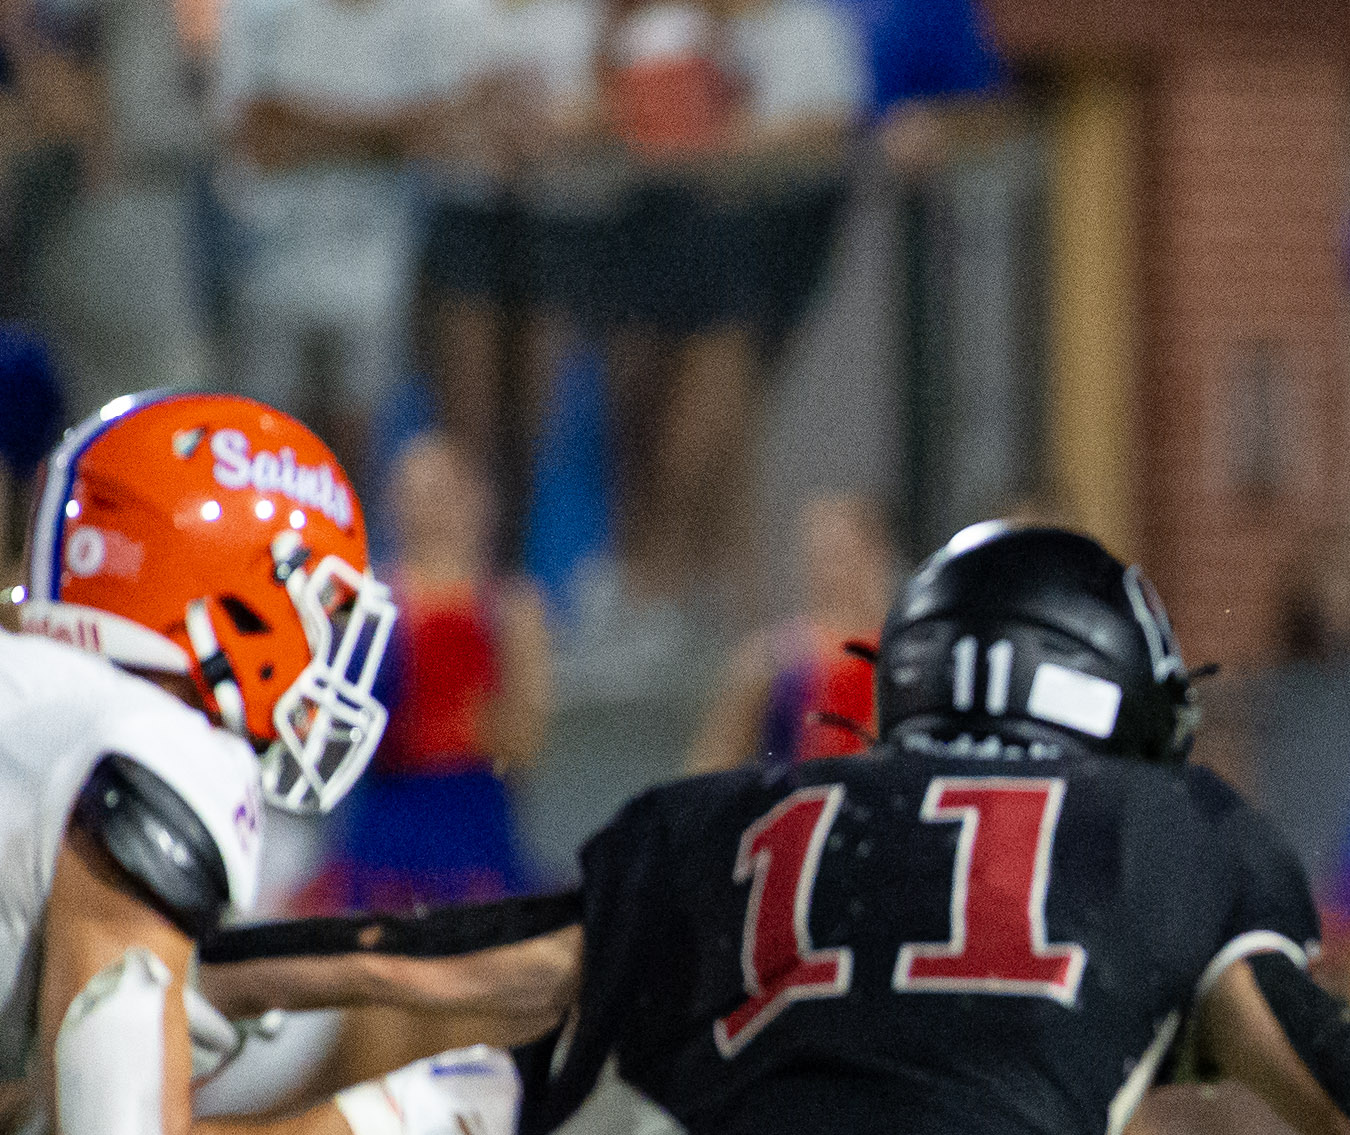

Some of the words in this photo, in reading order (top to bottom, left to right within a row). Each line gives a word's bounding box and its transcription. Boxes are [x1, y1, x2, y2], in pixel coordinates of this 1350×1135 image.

[209, 428, 353, 531] Saints
[952, 634, 1014, 717] 11
[712, 775, 1088, 1060] 11
